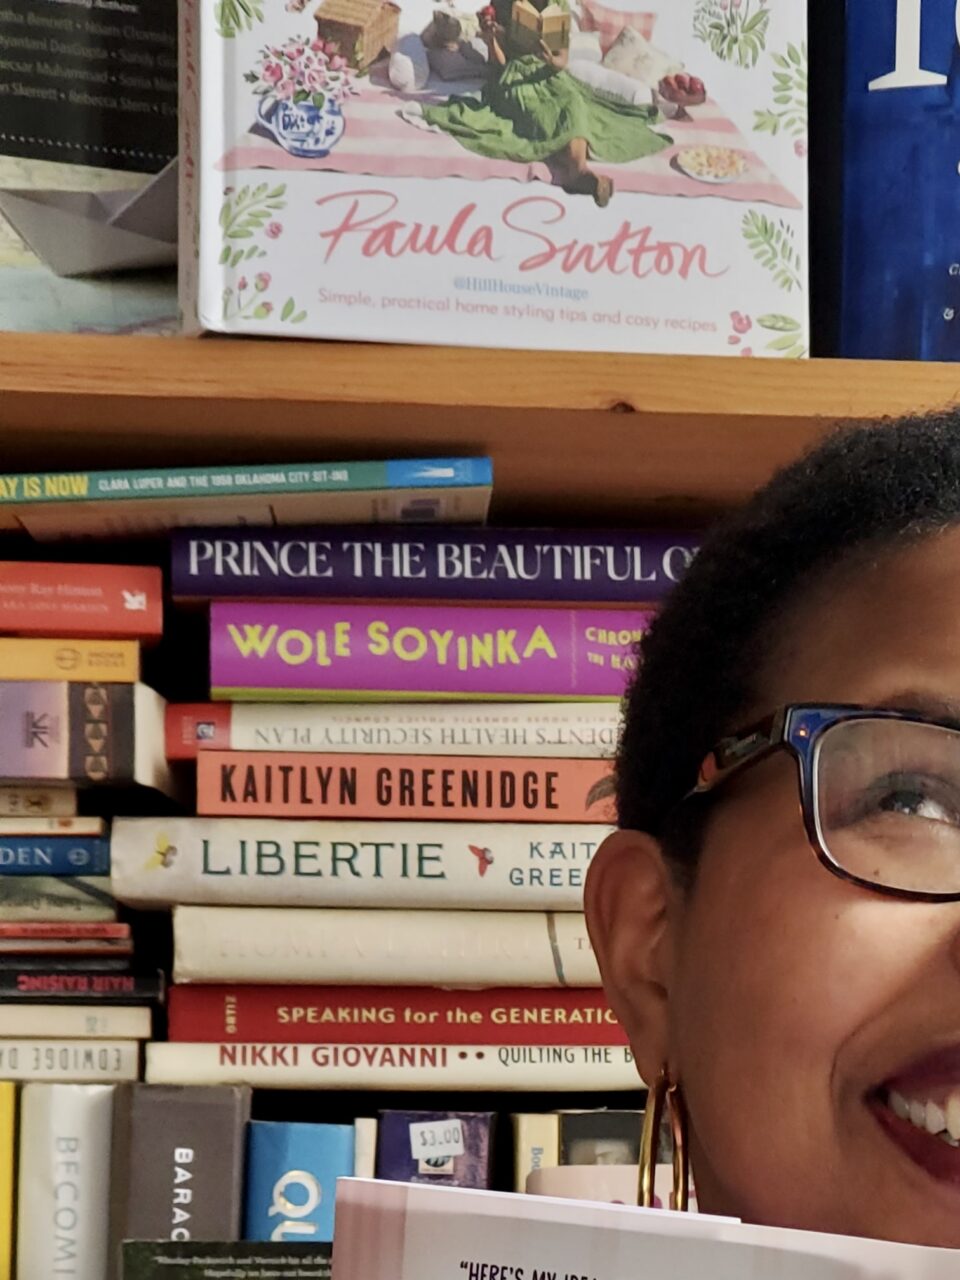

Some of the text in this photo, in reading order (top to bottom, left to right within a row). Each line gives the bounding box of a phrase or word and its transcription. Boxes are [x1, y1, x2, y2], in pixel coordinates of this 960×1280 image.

[315, 190, 730, 279] Paula Sutton
[453, 275, 589, 300] @HillHouseVintage
[317, 288, 377, 307] Simple,
[382, 292, 449, 314] practical
[455, 298, 498, 315] home
[502, 302, 554, 323] styling
[559, 308, 587, 325] tips
[594, 309, 621, 325] and
[664, 316, 717, 333] recipes
[23, 475, 88, 497] IS NOW
[166, 476, 187, 488] AND
[190, 475, 208, 487] THE
[235, 471, 286, 485] OKLAHOMA
[289, 471, 310, 483] CITY
[188, 540, 656, 583] PRINCE THE BEAUTIFUL
[227, 622, 351, 666] WOLE
[367, 621, 558, 671] SOYINKA
[254, 727, 313, 744] PLAN
[321, 727, 432, 745] SECURITY
[440, 726, 528, 745] HEALTH
[220, 764, 559, 809] KAITLYN GREENIDGE
[201, 839, 446, 879] LIBERTIE
[530, 842, 596, 859] KAIT
[509, 868, 582, 886] GREE
[278, 1007, 482, 1023] SPEAKING for the
[32, 1048, 121, 1071] EDWIDGE
[218, 1046, 447, 1068] NIKKI GIOVANNI
[498, 1047, 612, 1066] QUILTING THE
[420, 1127, 461, 1146] $3.00
